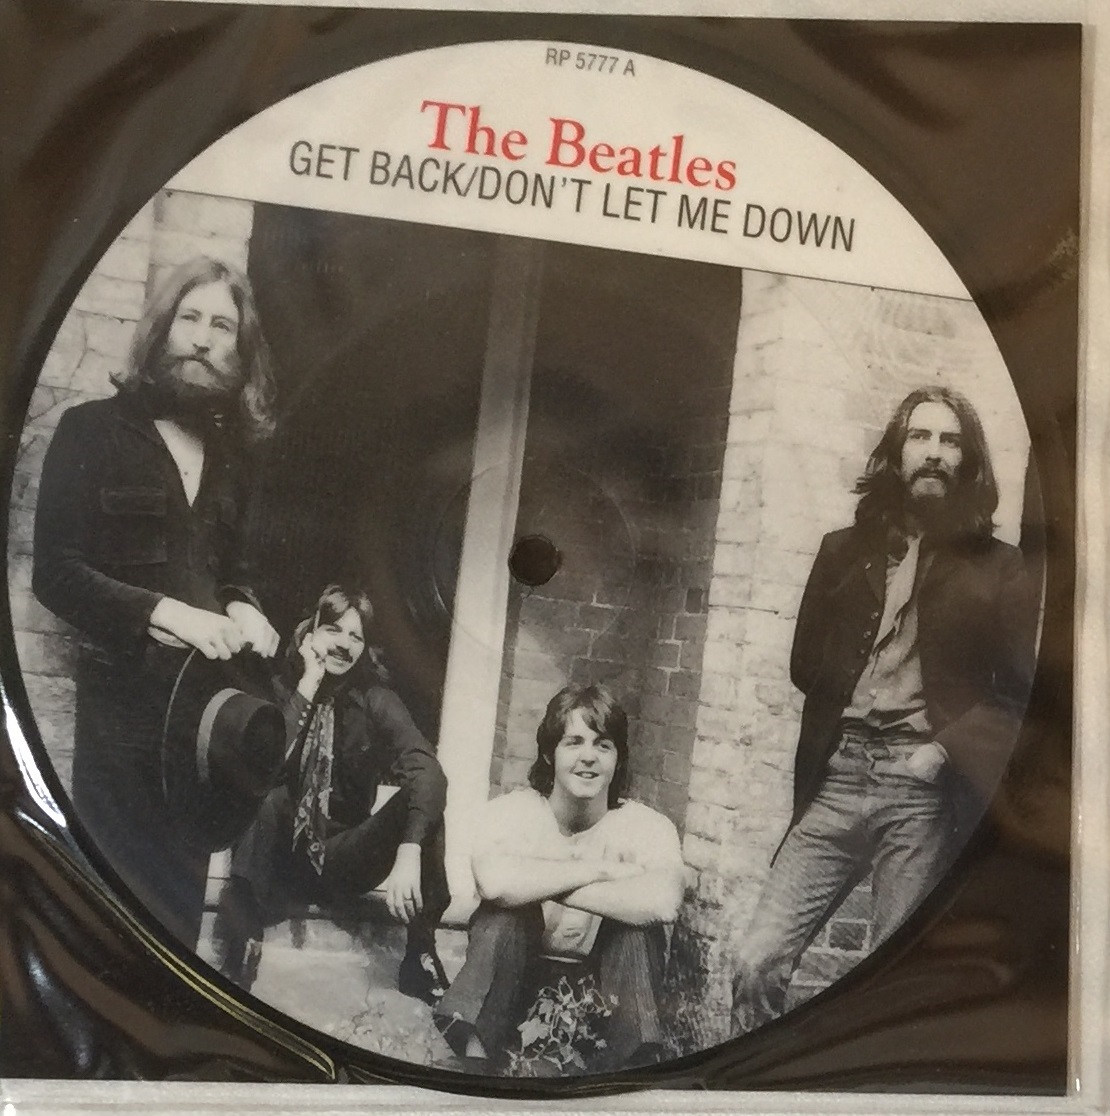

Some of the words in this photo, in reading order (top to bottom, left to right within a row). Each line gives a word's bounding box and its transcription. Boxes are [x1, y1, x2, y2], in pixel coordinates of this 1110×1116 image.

[545, 47, 571, 66] RP
[575, 51, 619, 73] 5777
[622, 58, 635, 77] A
[421, 99, 528, 161] The
[546, 117, 738, 191] Beatles
[289, 140, 360, 181] GET
[369, 150, 592, 212] BACK/DON'T
[602, 182, 667, 223] LET
[677, 194, 731, 234] ME
[742, 203, 855, 252] DOWN
